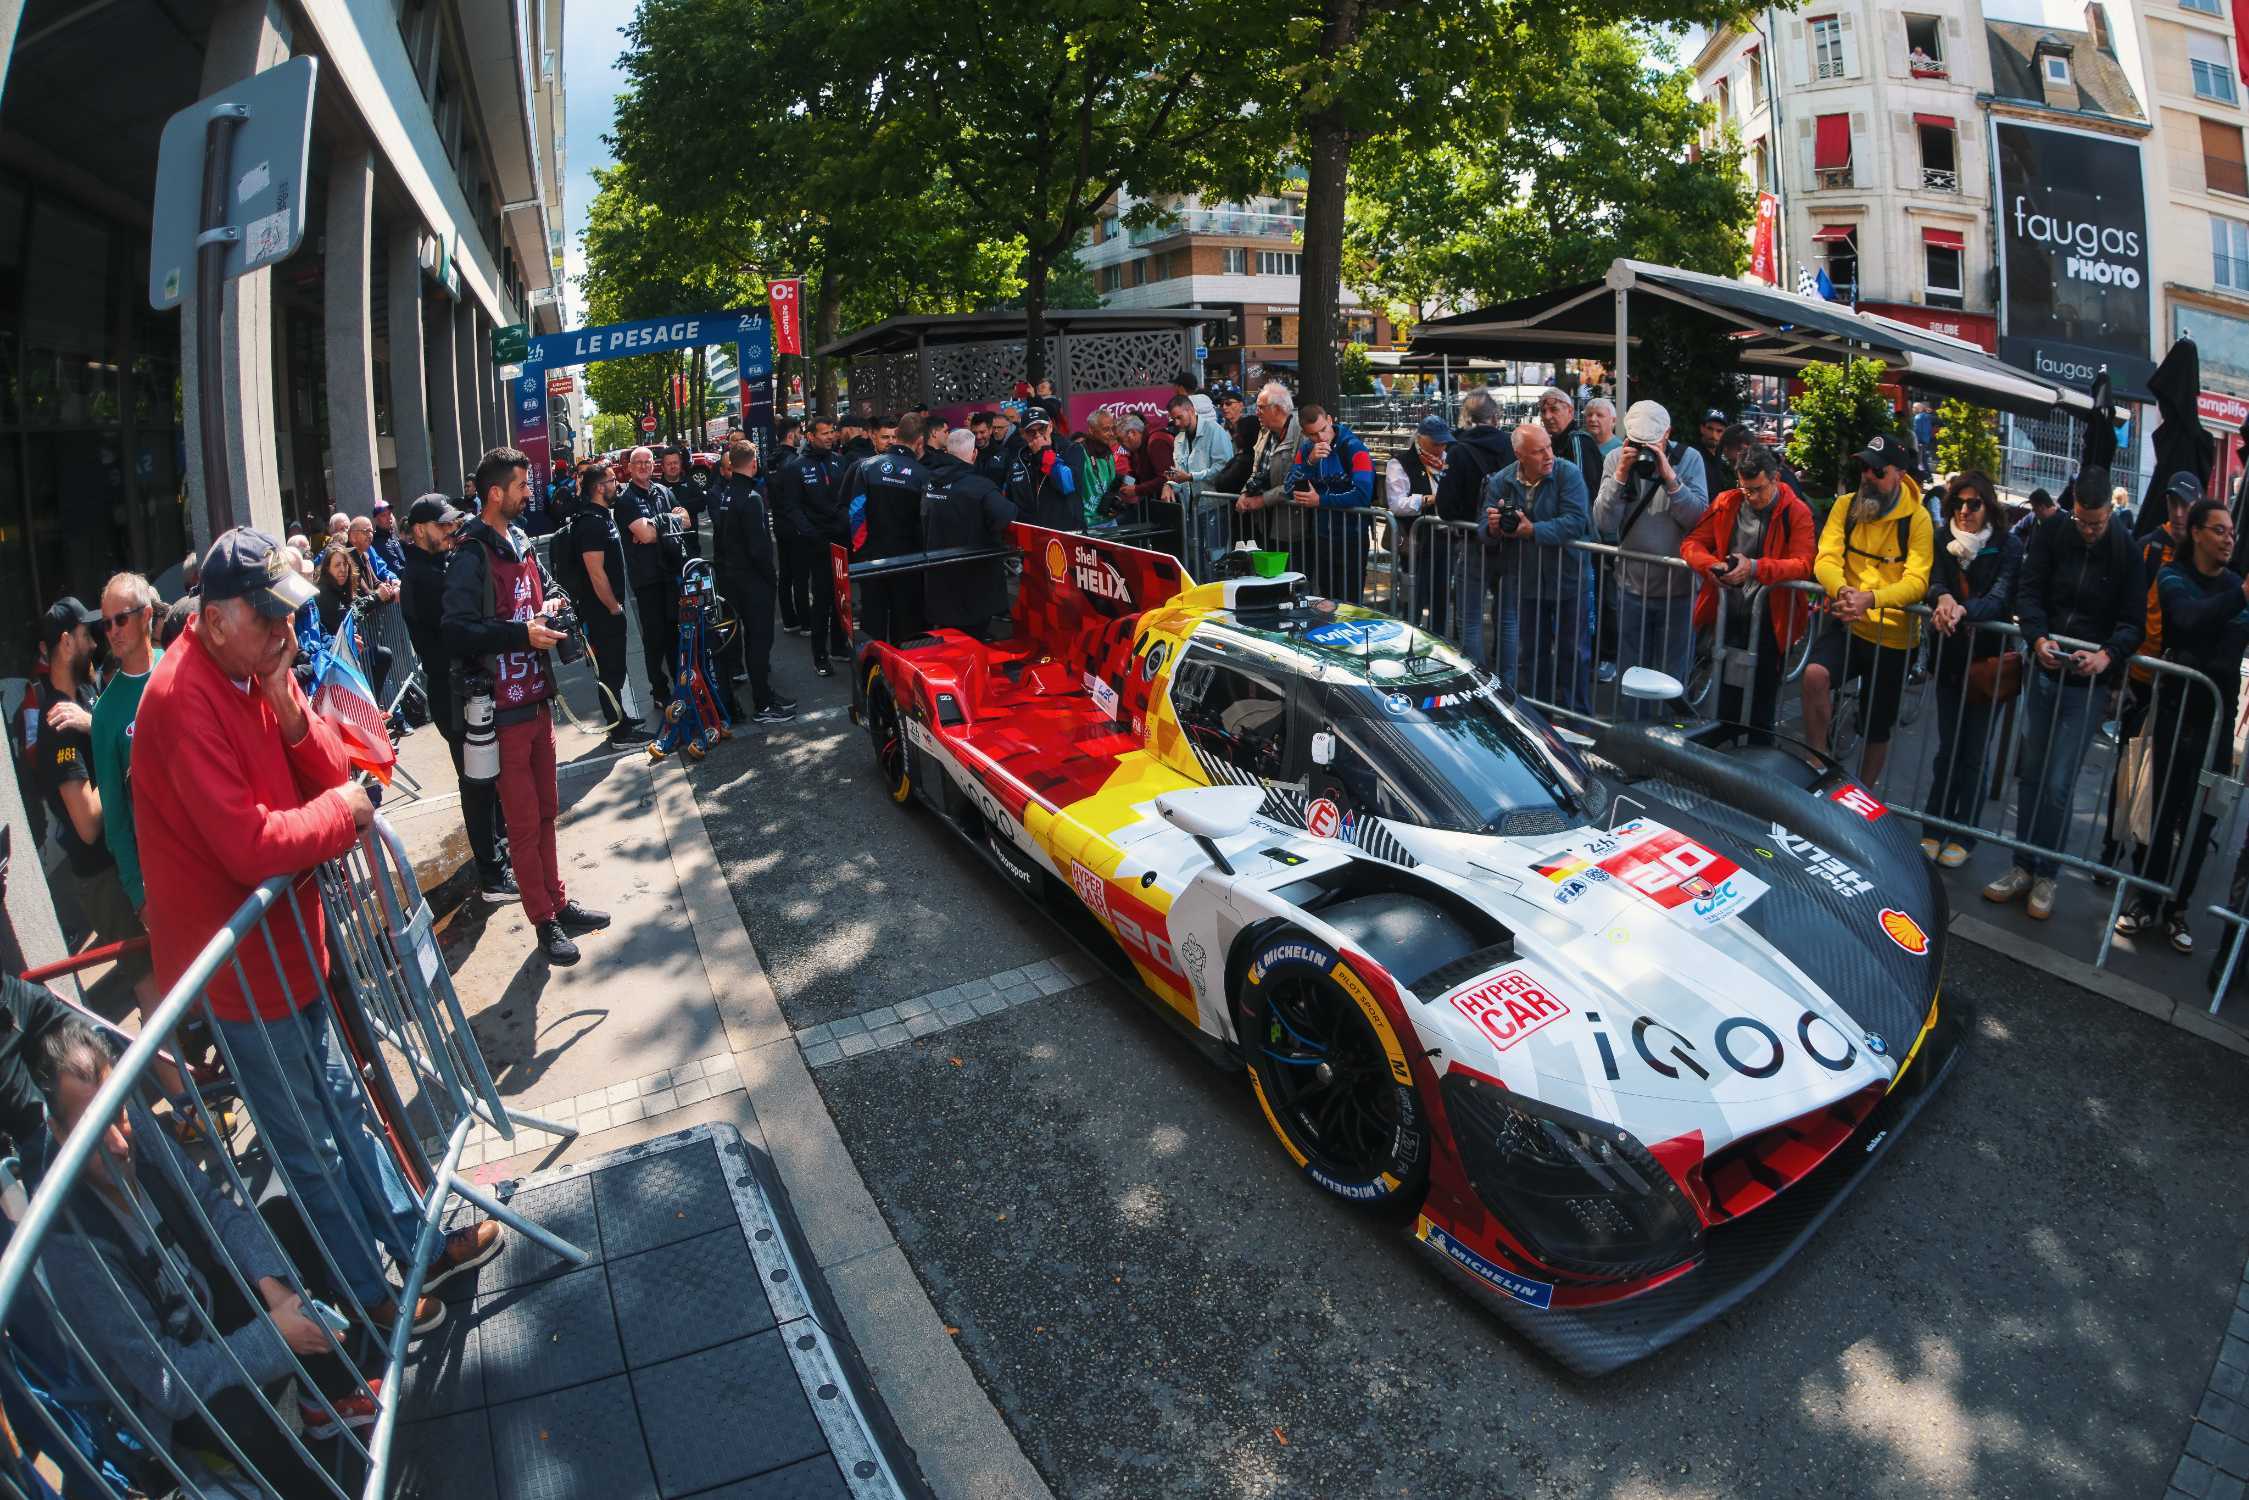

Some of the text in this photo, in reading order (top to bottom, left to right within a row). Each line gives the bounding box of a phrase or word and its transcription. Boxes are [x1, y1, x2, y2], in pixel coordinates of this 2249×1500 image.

[2014, 196, 2139, 256] faugas
[2066, 256, 2140, 289] PHOTO
[575, 321, 700, 355] LE PESAGE
[2036, 350, 2094, 379] faugas
[2197, 397, 2248, 418] amplifo
[1075, 546, 1097, 567] Shell
[1076, 562, 1131, 603] HELIX
[1767, 822, 1875, 893] HELIX
[1072, 862, 1103, 897] HYPER
[1804, 864, 1858, 898] Shell
[1074, 881, 1112, 920] CAR
[1263, 945, 1327, 968] MICHELIN
[1338, 971, 1384, 1028] PILOT SPORT
[1459, 976, 1533, 1014] HYPER
[1481, 989, 1559, 1040] CAR
[1585, 1010, 1857, 1081] iQOO
[1451, 1245, 1537, 1297] MICHELIN
